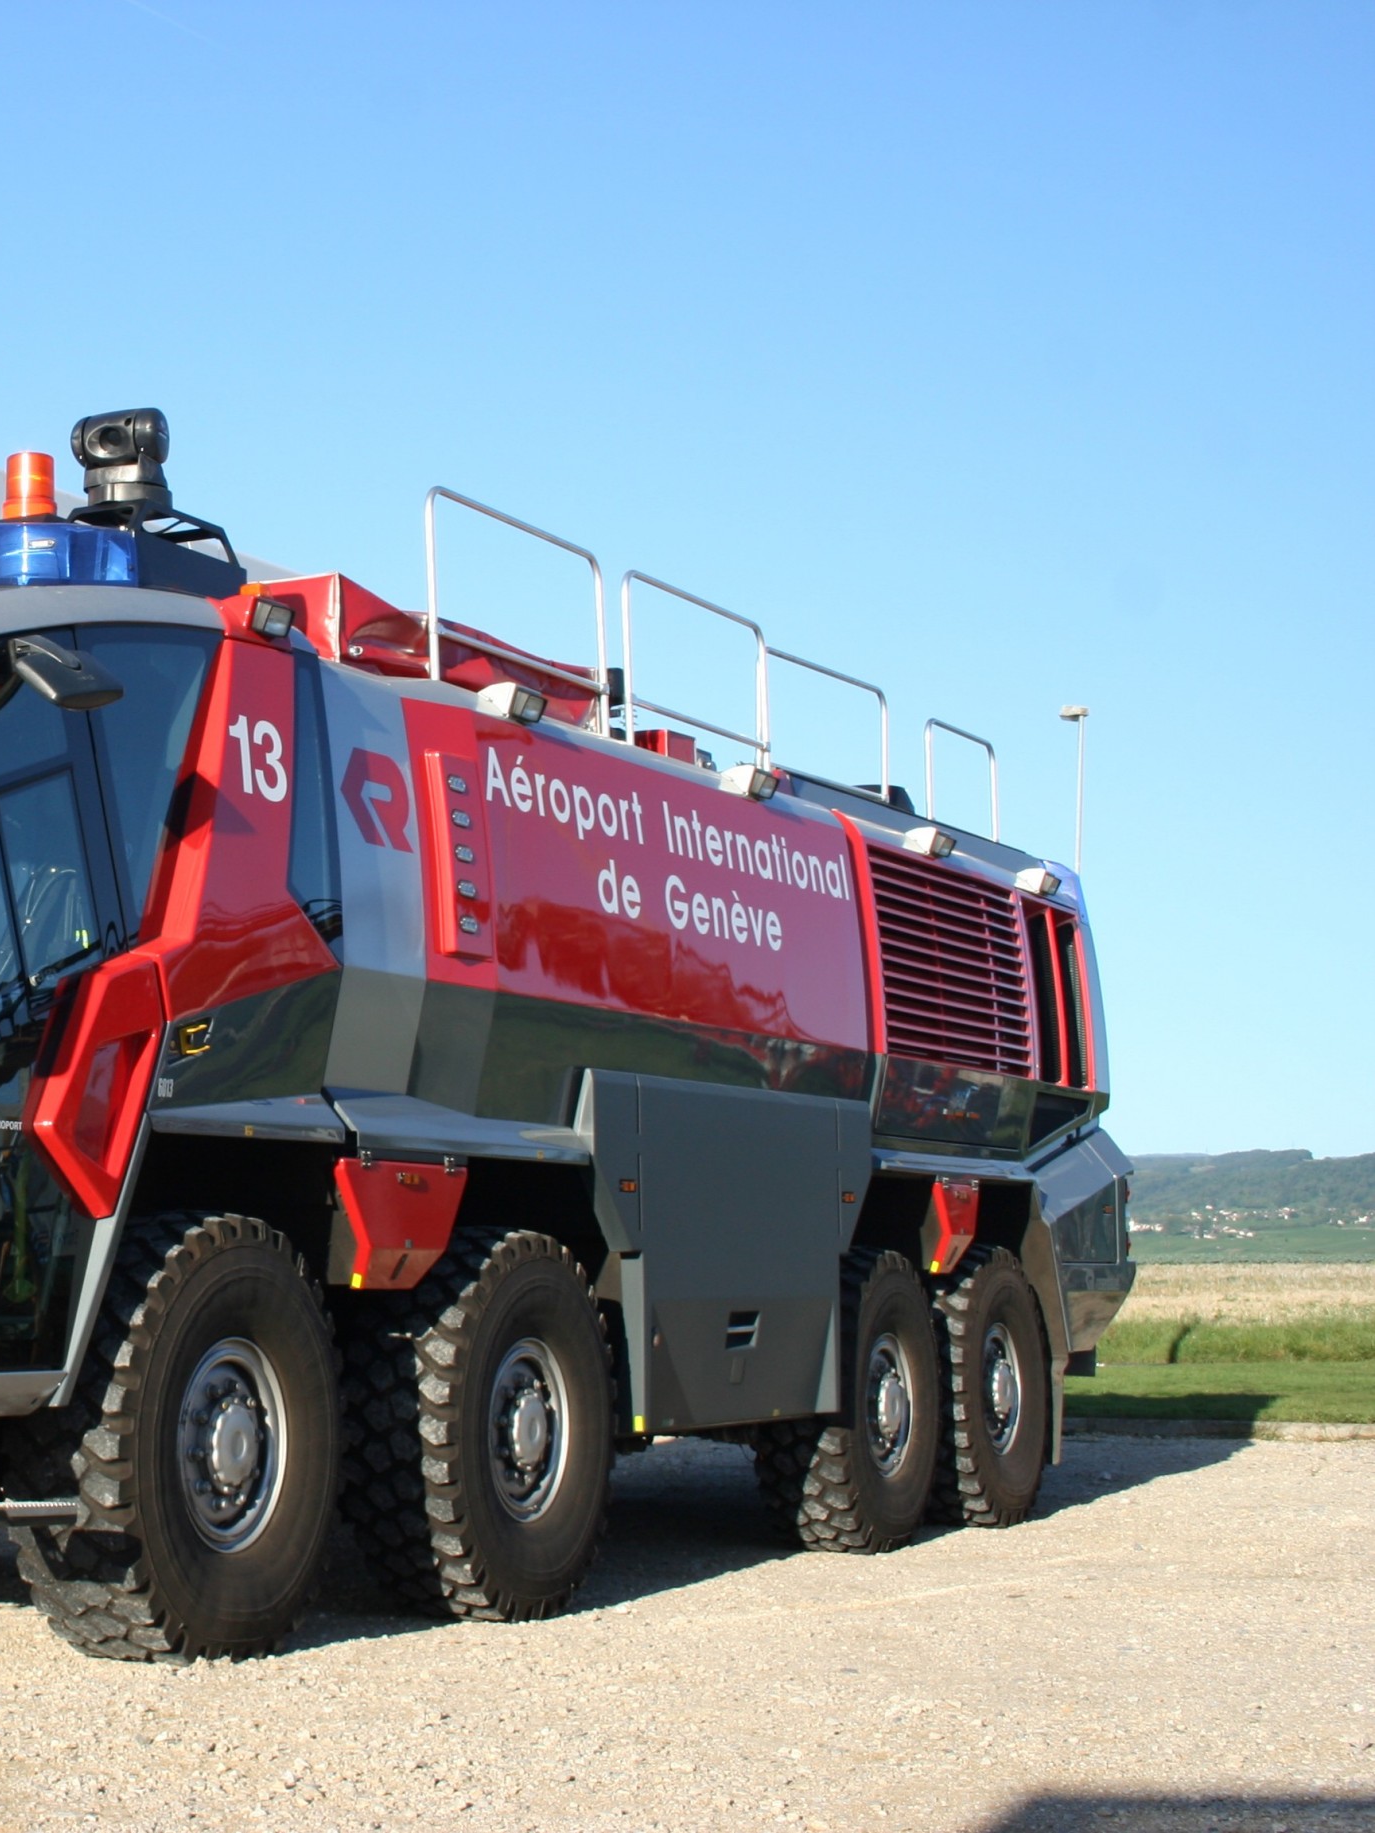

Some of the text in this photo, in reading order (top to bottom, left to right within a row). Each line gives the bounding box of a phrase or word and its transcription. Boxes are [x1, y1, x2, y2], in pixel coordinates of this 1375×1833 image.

[228, 714, 288, 803] 13
[485, 746, 851, 901] Aéroport International
[597, 859, 783, 952] de Genève
